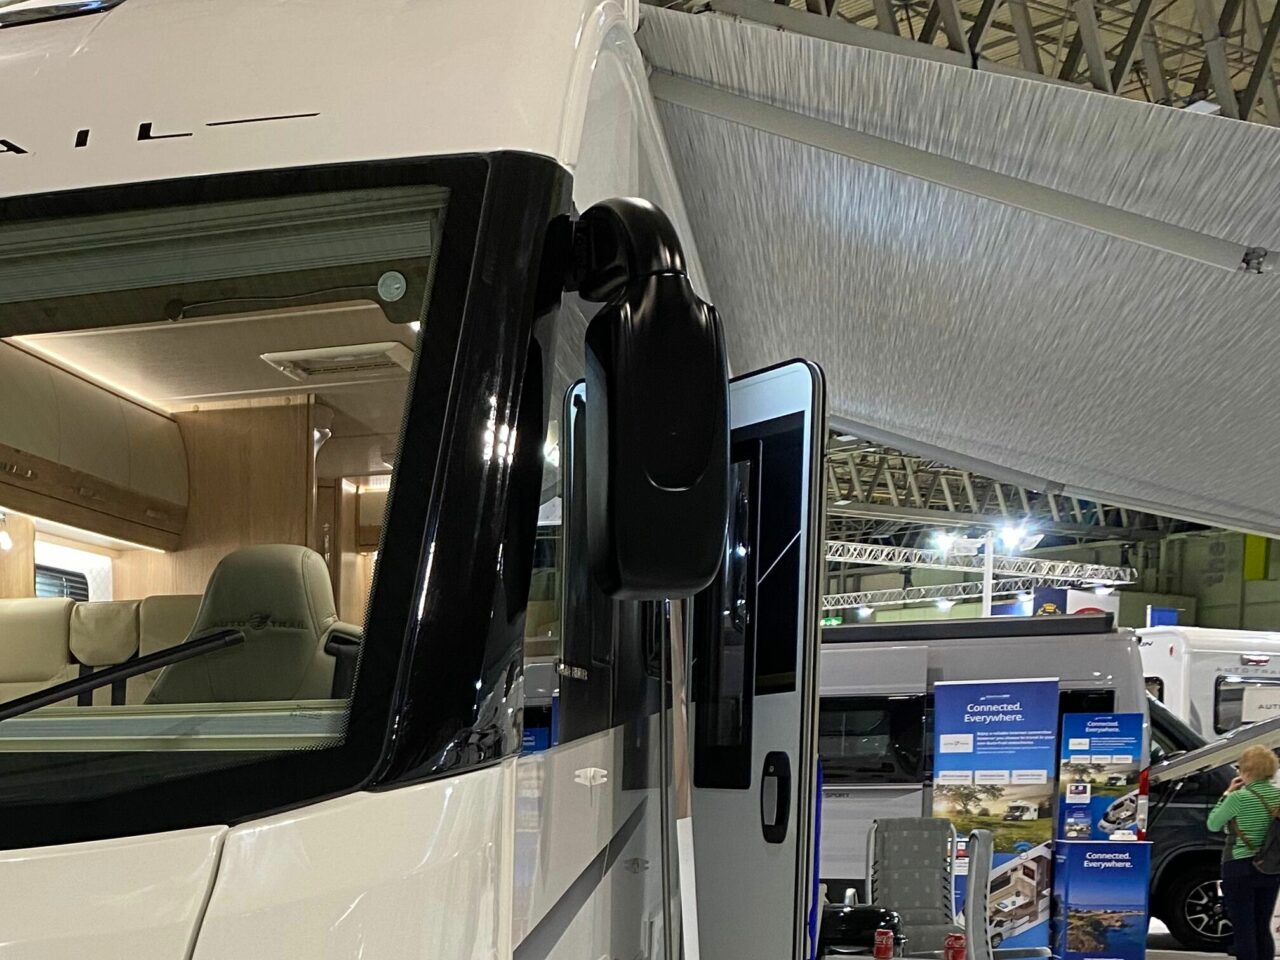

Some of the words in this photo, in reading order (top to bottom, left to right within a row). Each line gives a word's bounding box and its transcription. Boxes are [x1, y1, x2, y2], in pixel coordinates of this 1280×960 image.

[966, 702, 1023, 712] Connected.
[963, 713, 1025, 725] Everywhere.
[1085, 852, 1132, 860] Connected.
[1083, 860, 1134, 869] Everywhere.
